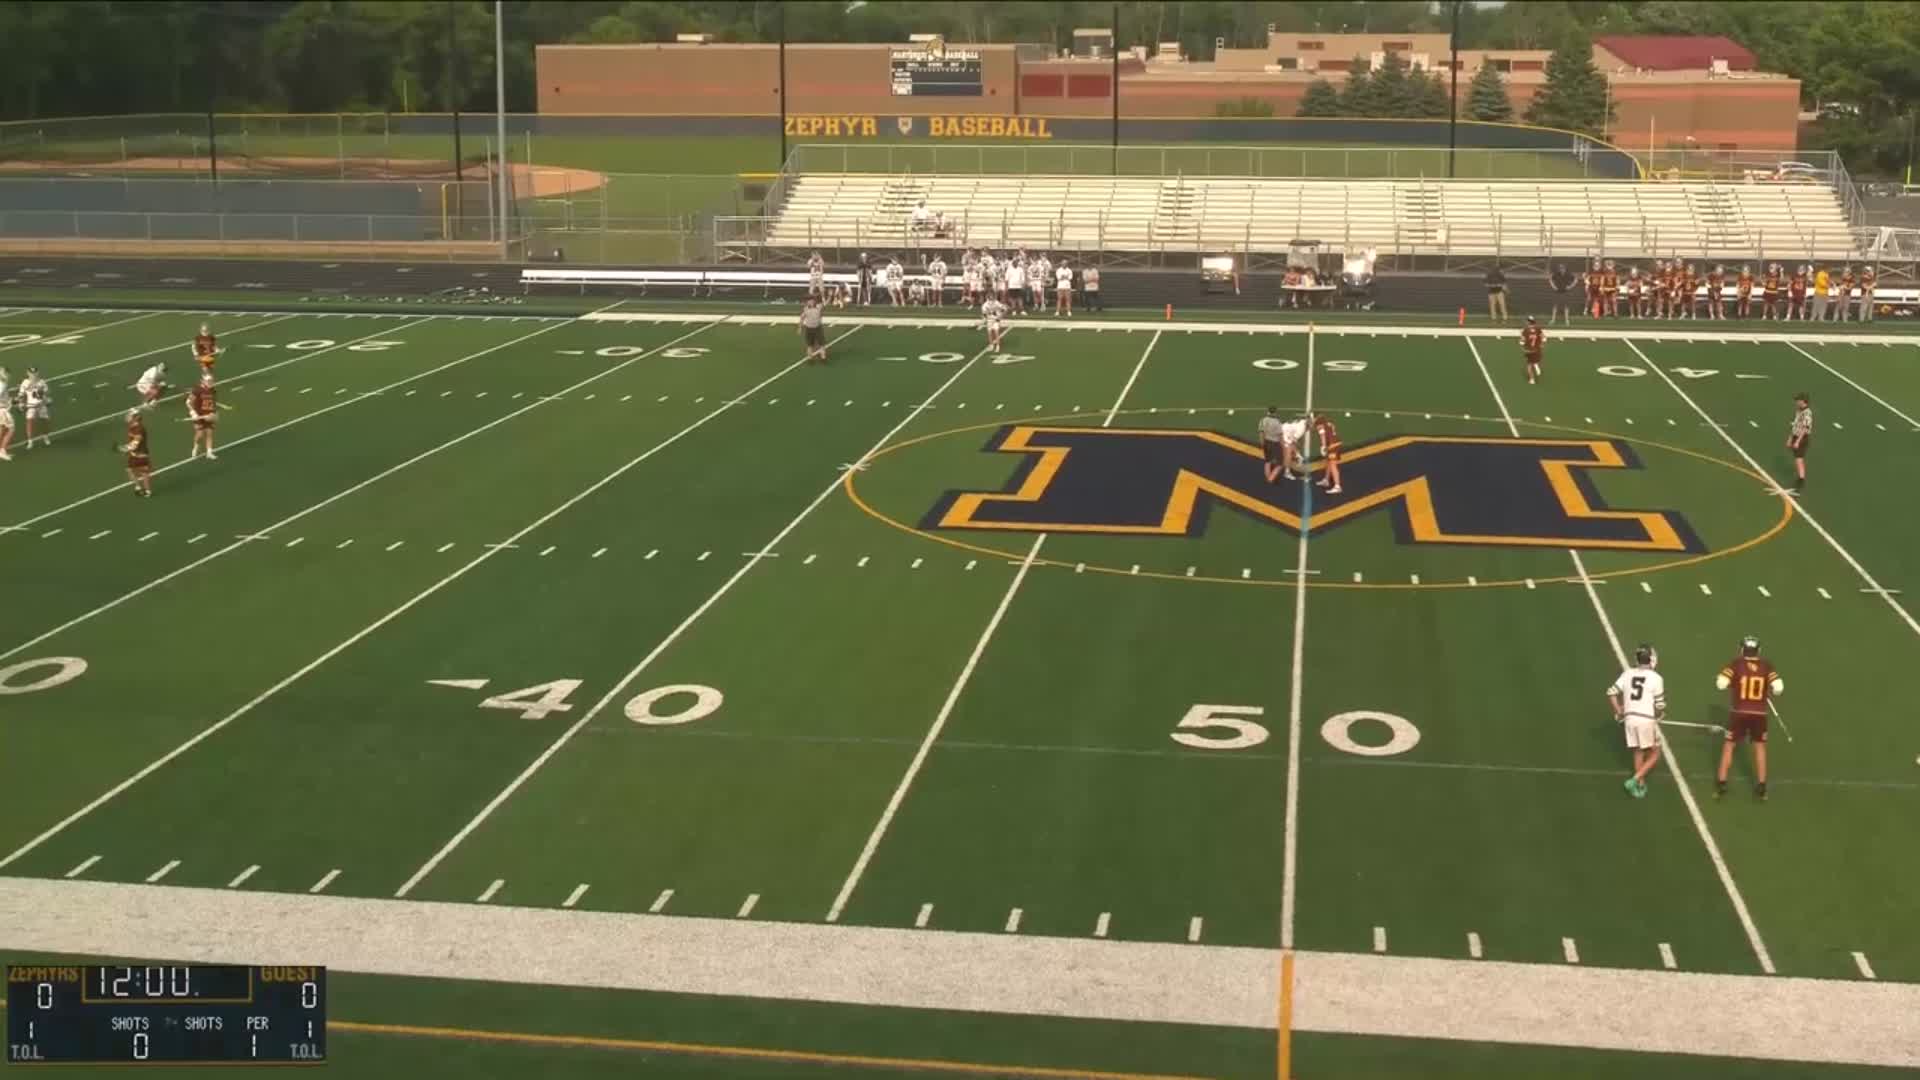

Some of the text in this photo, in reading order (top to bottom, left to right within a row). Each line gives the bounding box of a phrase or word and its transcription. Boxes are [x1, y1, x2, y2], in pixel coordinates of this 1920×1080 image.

[785, 117, 1053, 137] ZEPHYR BASEBALL
[918, 423, 1709, 555] M
[1631, 676, 1646, 701] 5
[1739, 676, 1765, 701] 10
